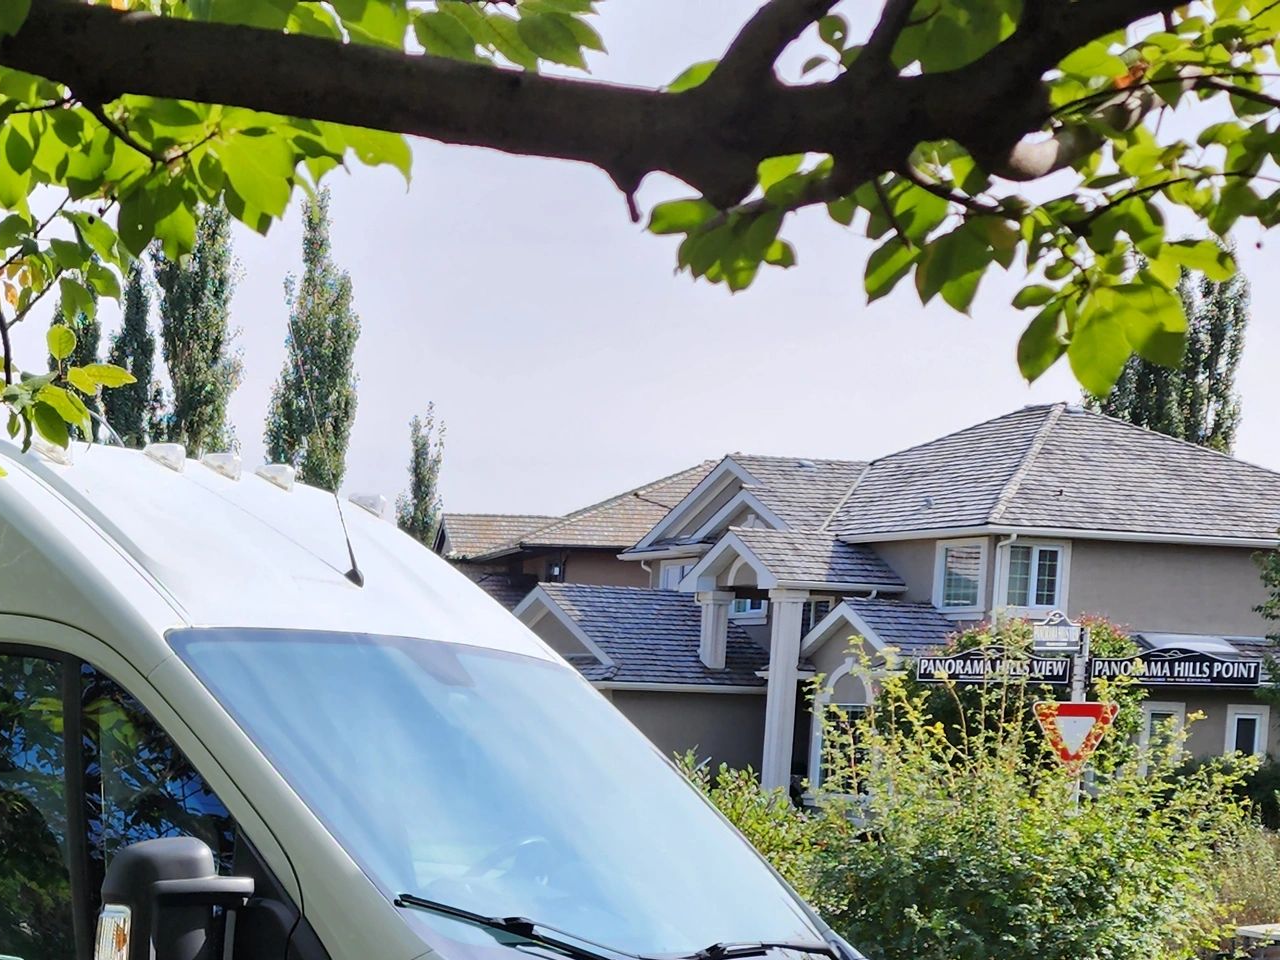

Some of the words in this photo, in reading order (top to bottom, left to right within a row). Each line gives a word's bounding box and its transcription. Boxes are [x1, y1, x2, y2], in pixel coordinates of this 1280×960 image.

[920, 659, 991, 675] PANORAMA
[996, 661, 1030, 676] HLLS
[1033, 661, 1066, 677] VIEW
[1174, 661, 1210, 678] HILLS
[1213, 662, 1257, 679] POINT
